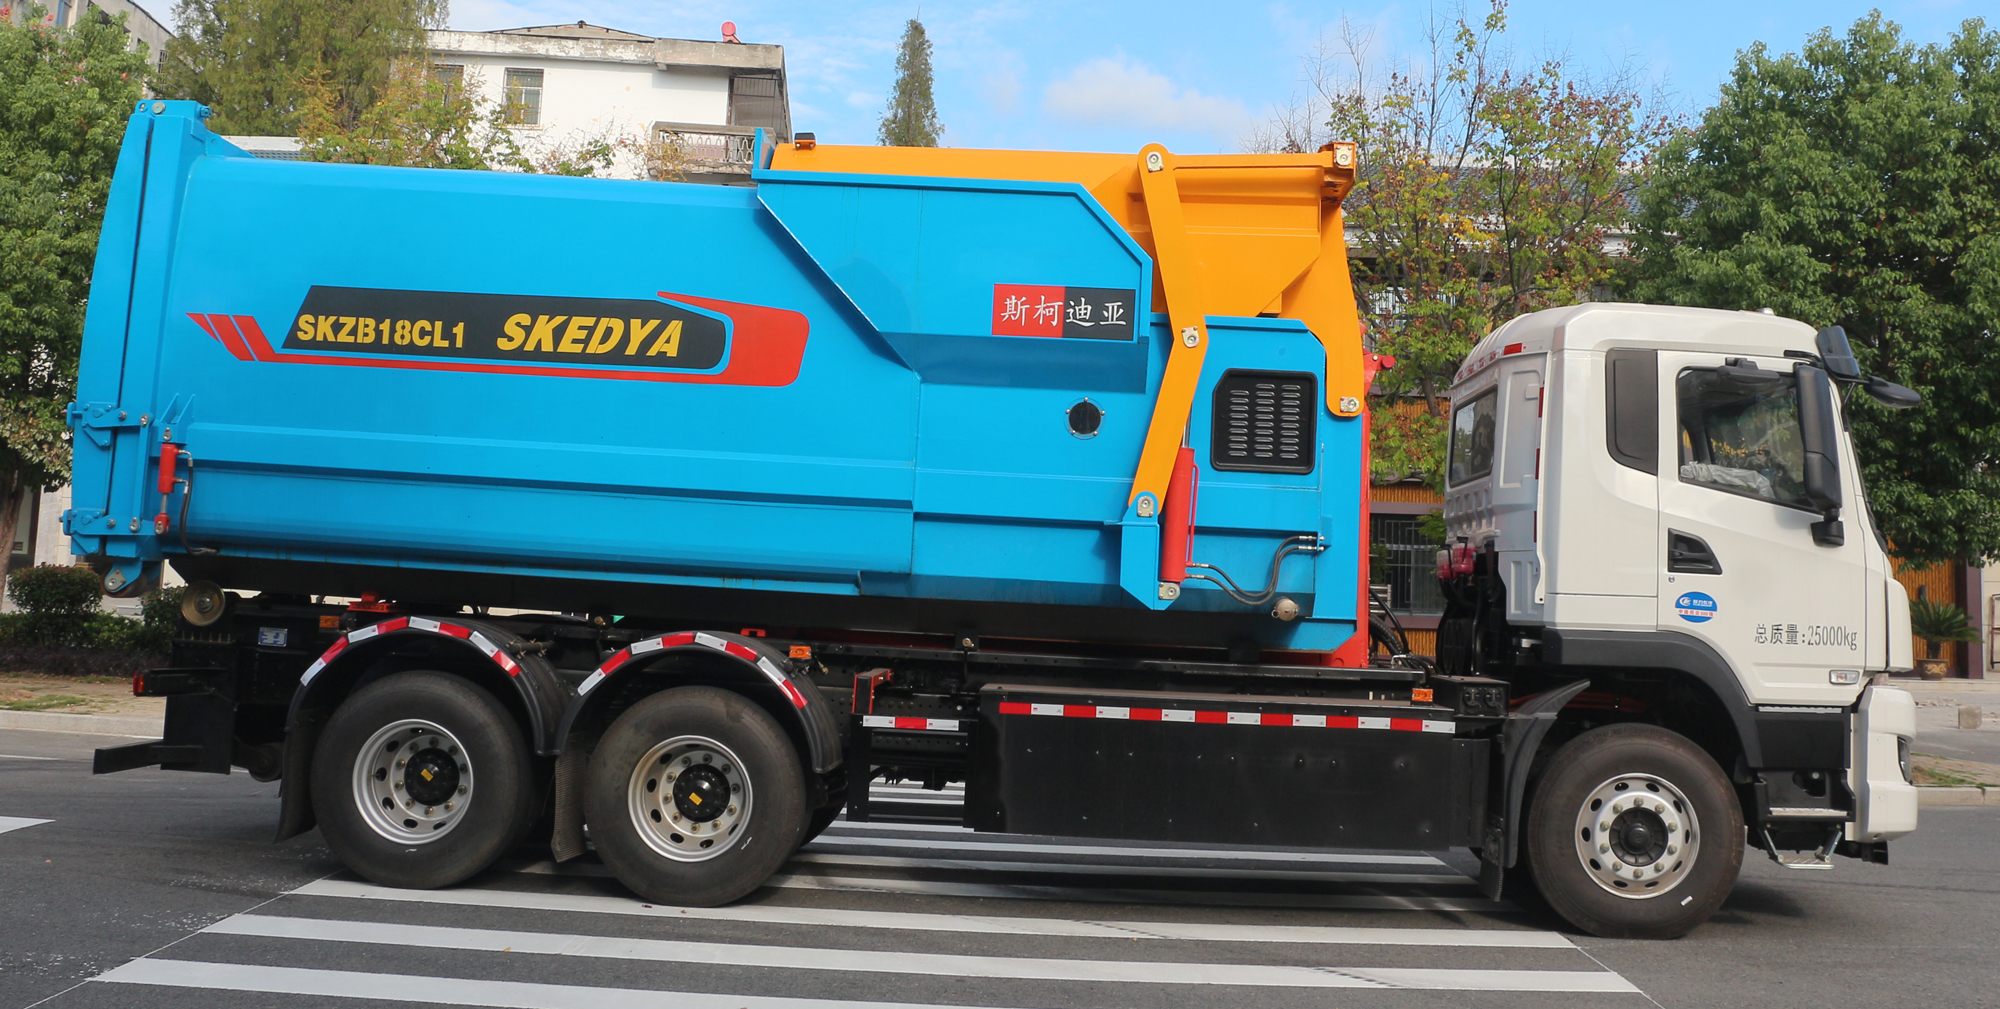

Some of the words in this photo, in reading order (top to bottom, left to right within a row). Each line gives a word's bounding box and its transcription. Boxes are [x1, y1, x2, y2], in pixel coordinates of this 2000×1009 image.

[1000, 294, 1127, 327] 斯柯迪亚
[296, 314, 465, 348] SKZB18CL1
[496, 313, 683, 357] SKEDYA
